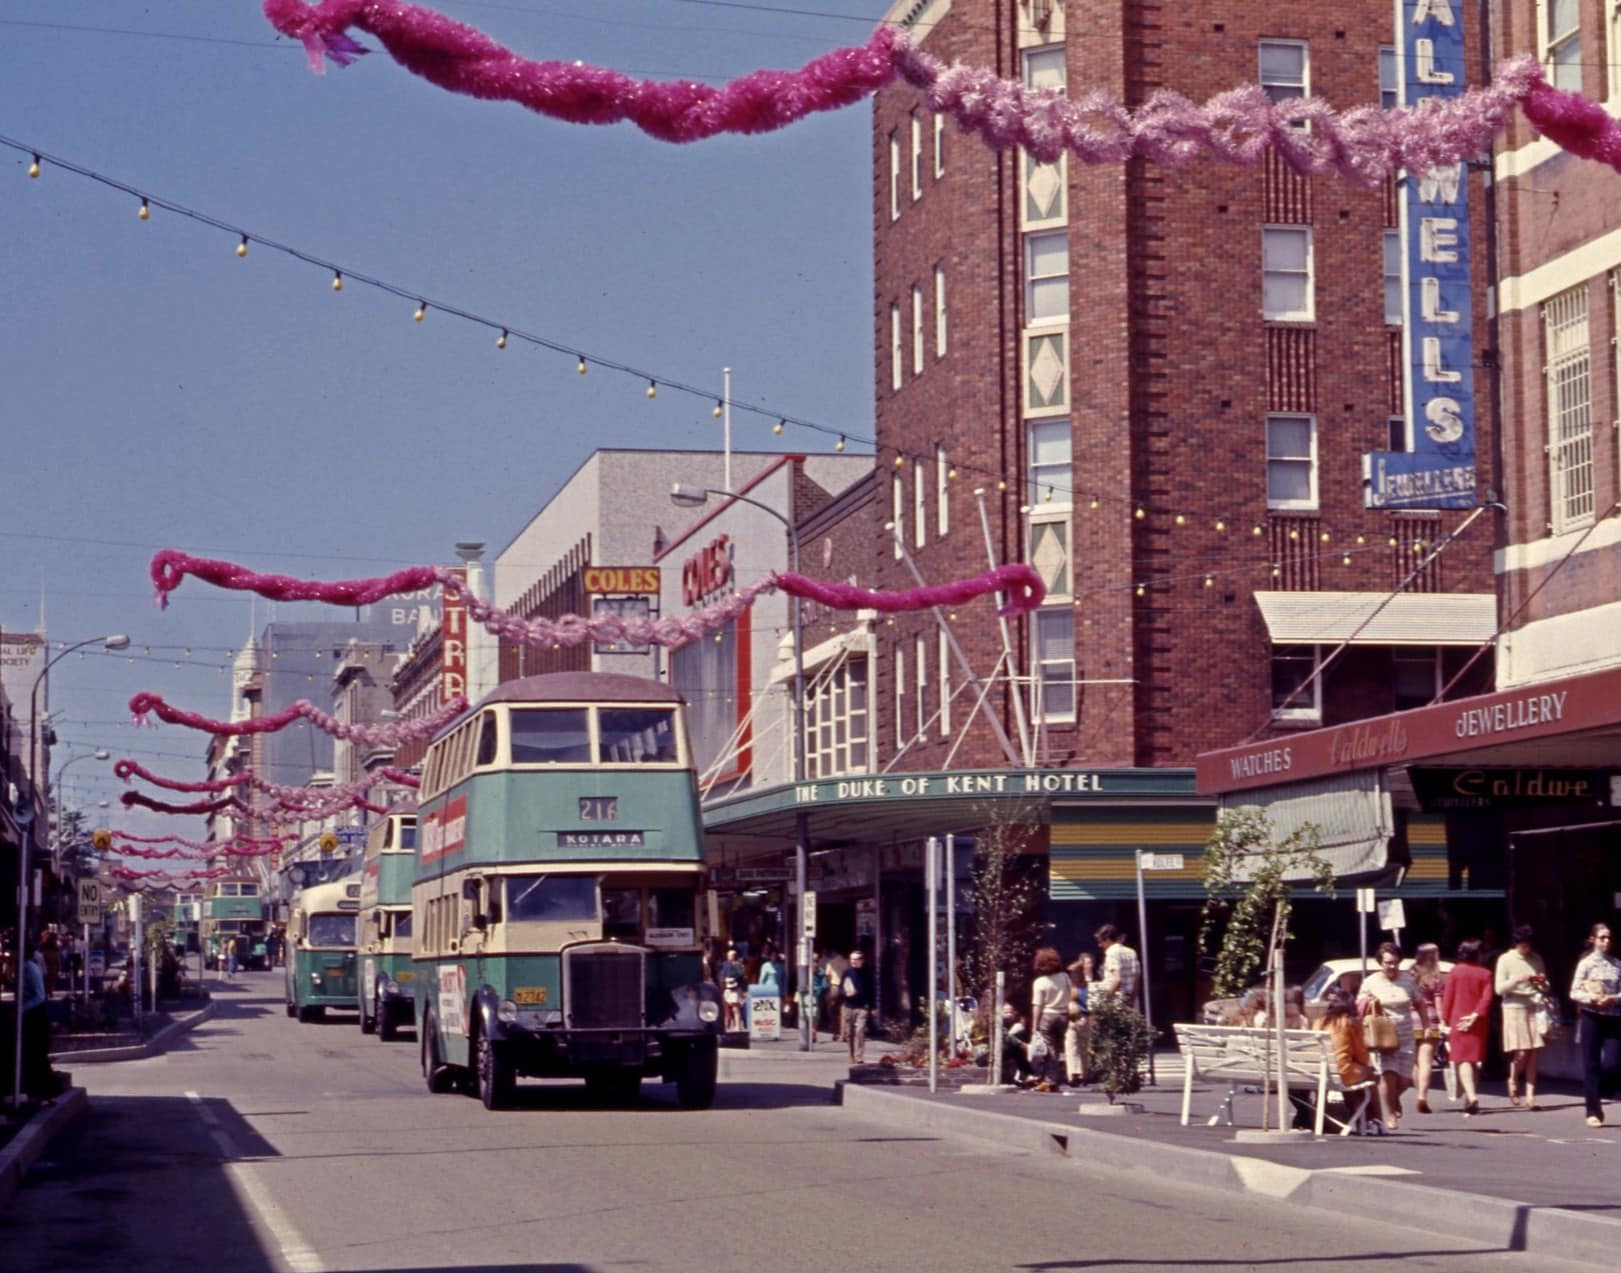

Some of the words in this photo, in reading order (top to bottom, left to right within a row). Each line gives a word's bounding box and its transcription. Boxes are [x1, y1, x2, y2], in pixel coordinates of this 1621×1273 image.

[1411, 0, 1464, 443] ALWELLS
[585, 569, 658, 591] COLES
[1230, 747, 1292, 780] WATCHES
[1456, 691, 1568, 739] JEWELLERY
[795, 785, 817, 802] THE
[838, 780, 885, 798] DUKE
[901, 778, 929, 795] OF
[947, 776, 1008, 794] KENT
[1025, 774, 1104, 793] HOTEL
[581, 800, 618, 821] 216
[566, 834, 641, 844] KOTARA
[82, 885, 97, 901] NO
